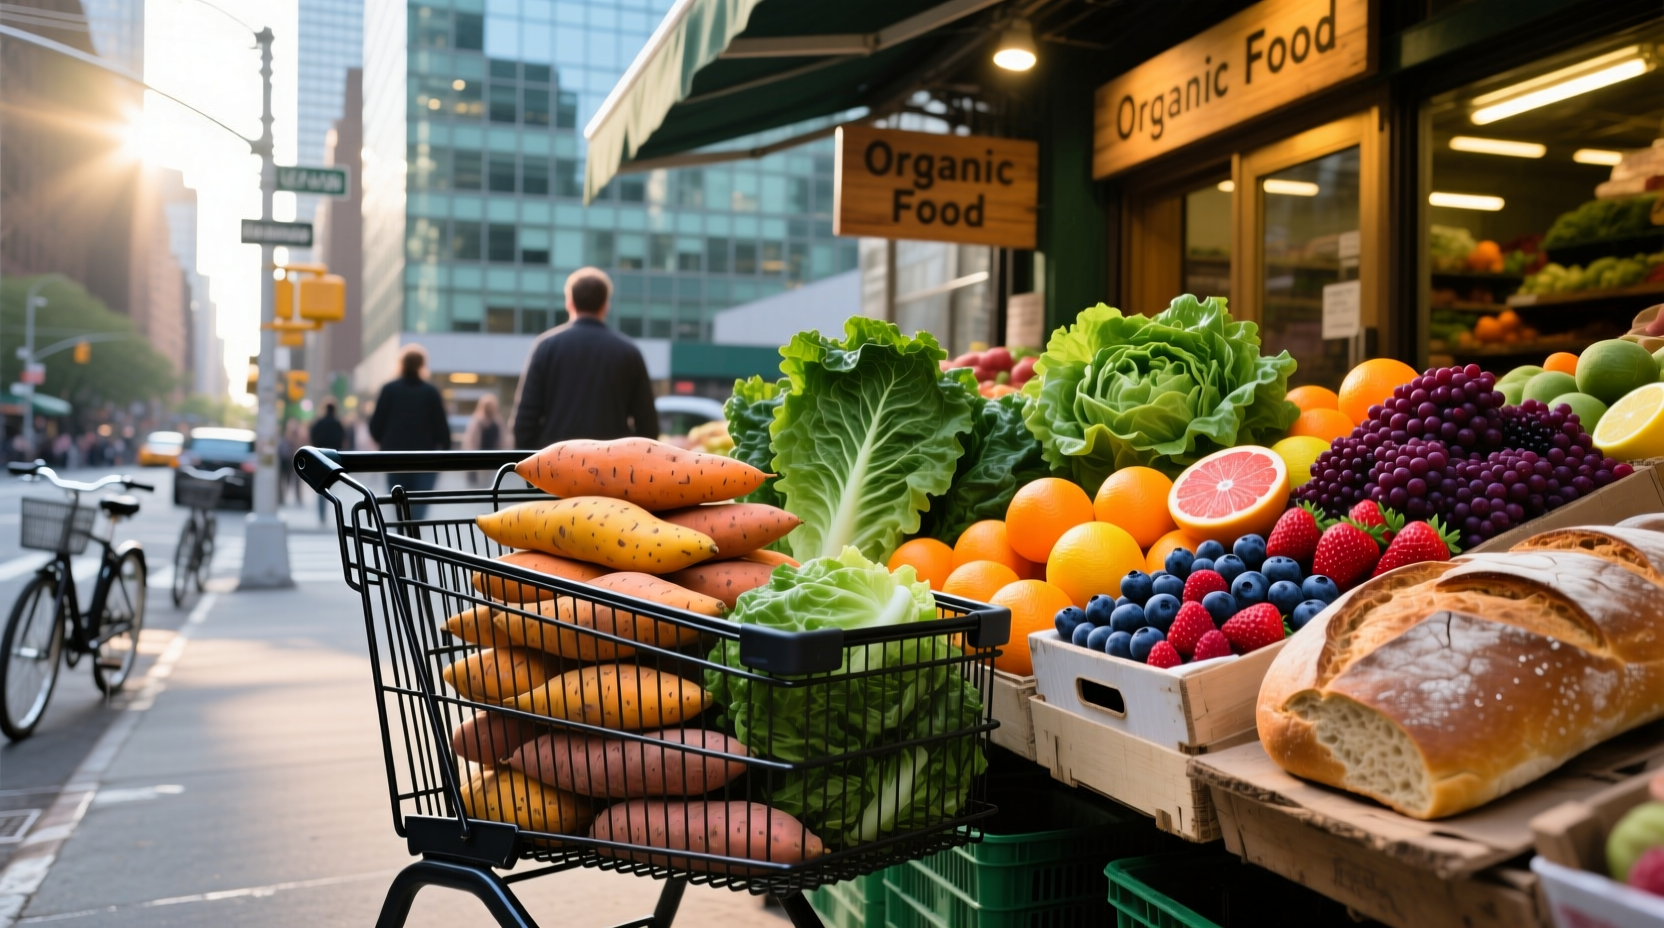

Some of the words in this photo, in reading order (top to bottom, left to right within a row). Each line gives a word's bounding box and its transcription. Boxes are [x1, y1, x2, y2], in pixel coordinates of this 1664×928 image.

[1117, 56, 1229, 140] Organic
[1245, 0, 1336, 85] Food
[864, 139, 1014, 190] Organic
[892, 188, 984, 228] Food
